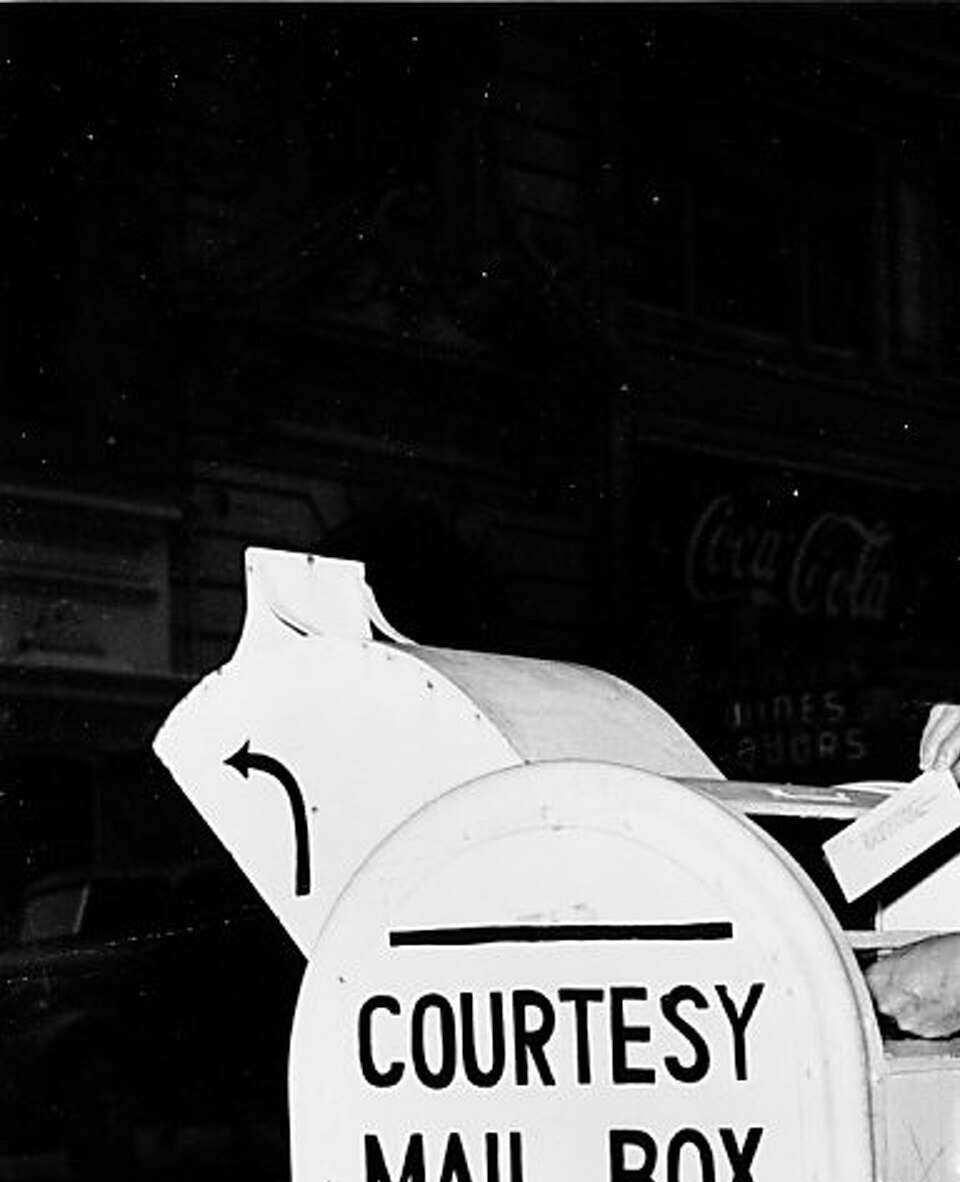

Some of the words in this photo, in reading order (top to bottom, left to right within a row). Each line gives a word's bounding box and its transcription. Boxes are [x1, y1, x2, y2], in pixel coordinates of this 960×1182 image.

[685, 493, 783, 604] Coca
[787, 511, 893, 621] Cola
[358, 983, 765, 1089] COURTESY
